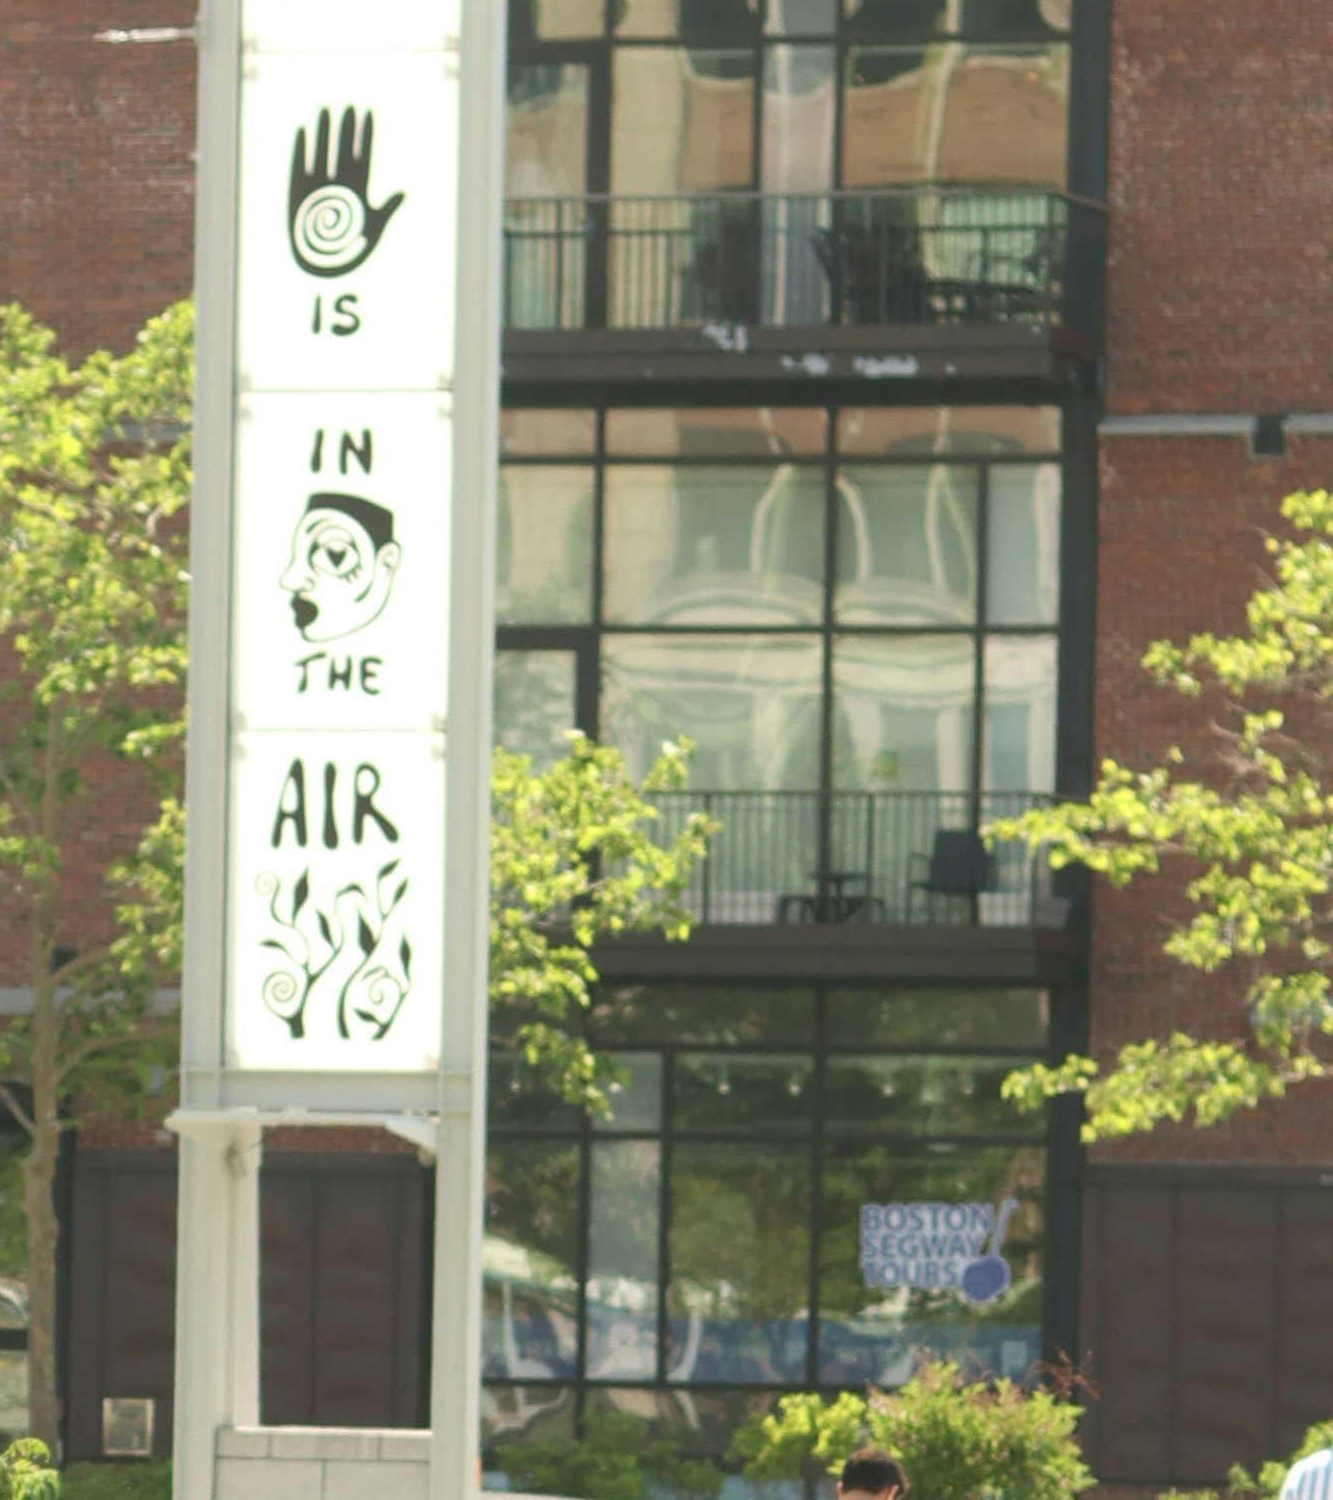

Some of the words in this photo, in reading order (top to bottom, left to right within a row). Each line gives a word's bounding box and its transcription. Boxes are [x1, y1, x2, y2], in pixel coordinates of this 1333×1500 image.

[312, 294, 361, 336] IS
[310, 428, 373, 475] IN
[294, 652, 383, 695] THE
[271, 758, 399, 849] AIR
[863, 1204, 993, 1231] BOSTON
[863, 1233, 981, 1257] SEGWAY
[865, 1261, 959, 1286] TOURS
